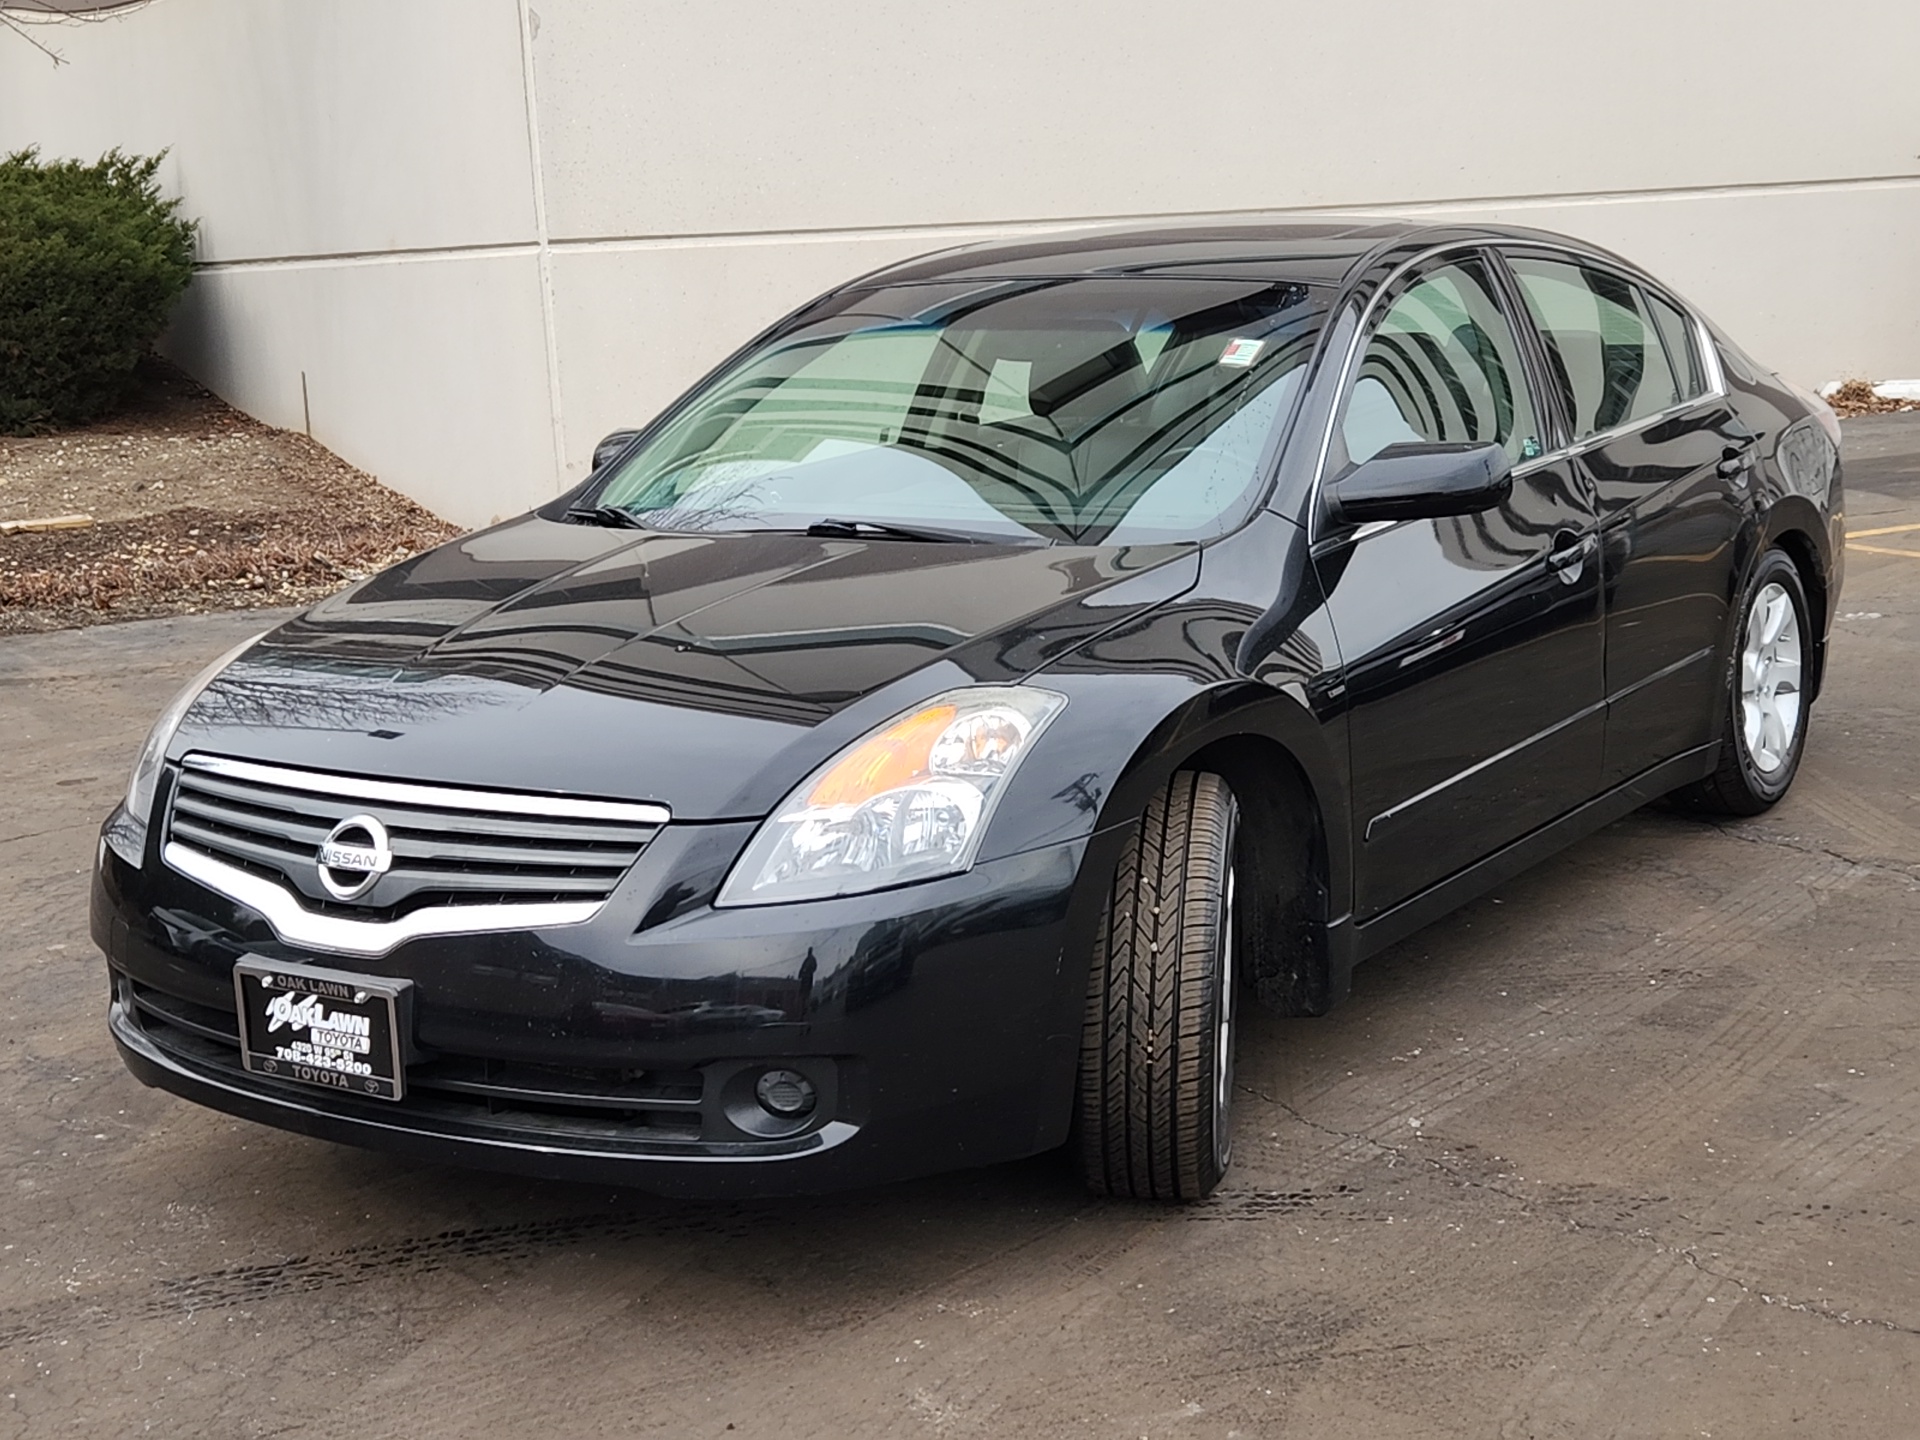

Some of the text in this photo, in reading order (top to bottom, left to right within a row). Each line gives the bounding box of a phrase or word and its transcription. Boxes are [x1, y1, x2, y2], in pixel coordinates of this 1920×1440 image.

[317, 847, 377, 867] NISSAN
[277, 975, 350, 998] OAK LAWN
[316, 1031, 363, 1051] TOYOTA
[292, 1064, 349, 1088] TOYOTA
